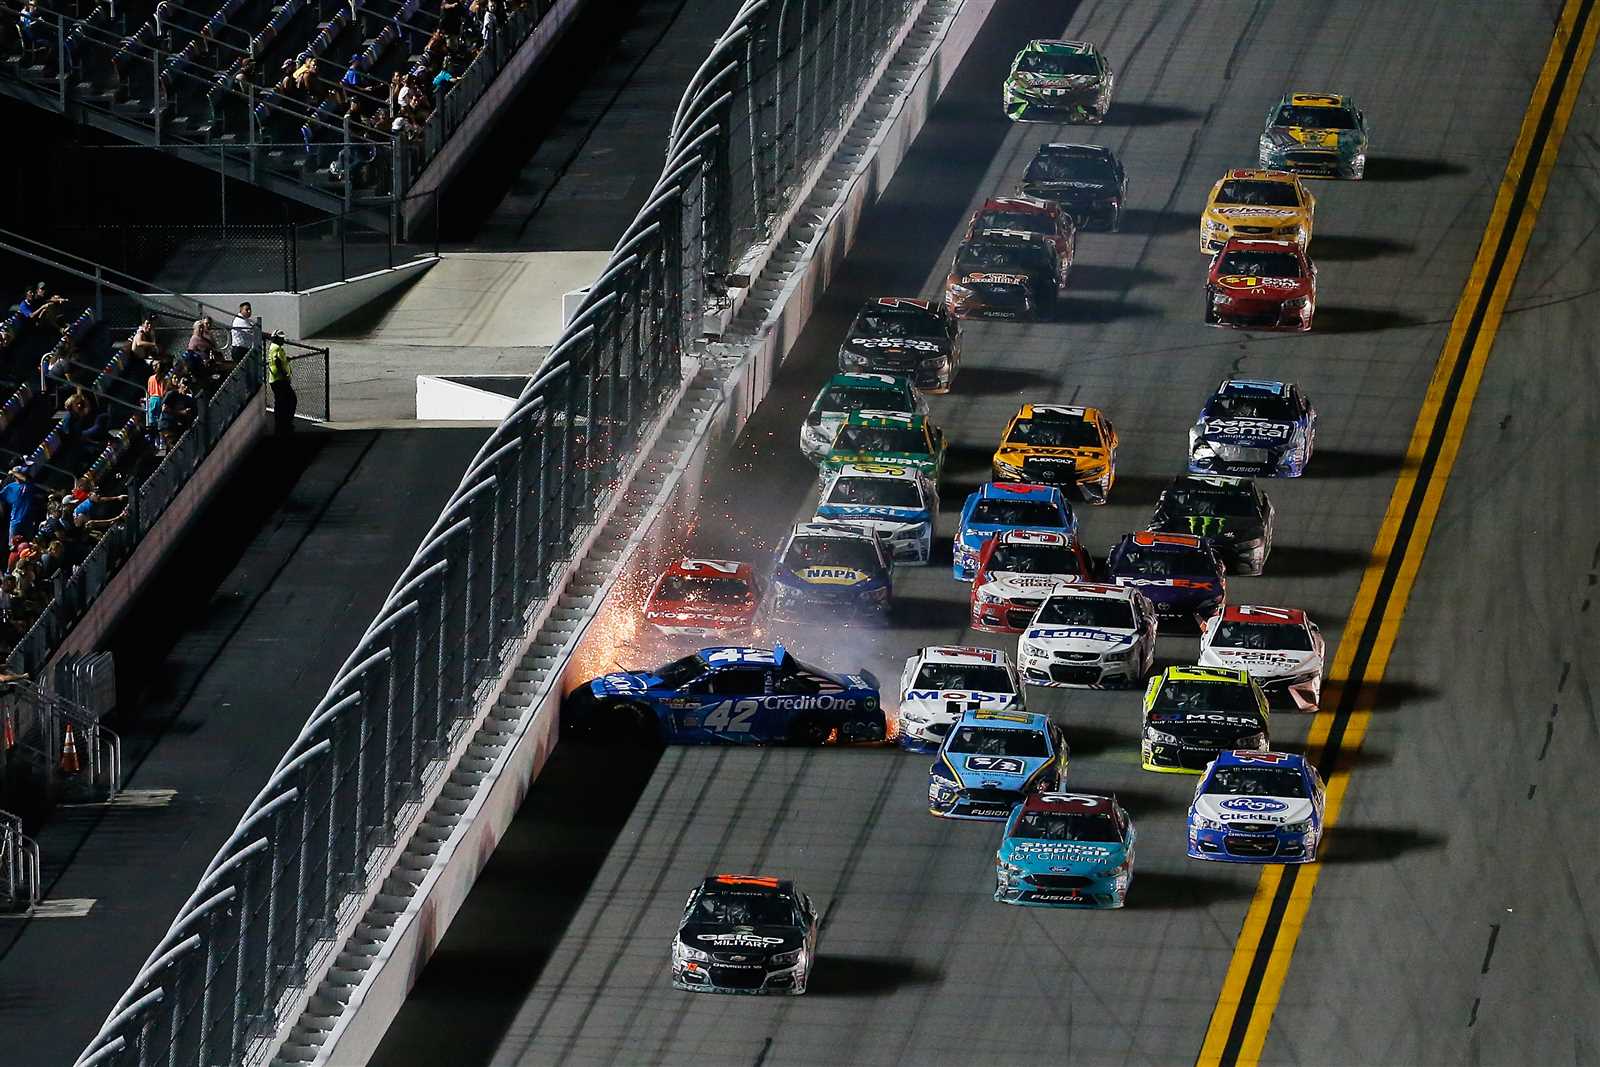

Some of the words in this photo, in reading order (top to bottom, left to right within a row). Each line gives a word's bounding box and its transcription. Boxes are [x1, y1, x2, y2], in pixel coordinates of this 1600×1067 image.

[1209, 418, 1290, 430] Aspen
[1204, 425, 1289, 439] Dental
[831, 455, 934, 466] SUBWAY
[807, 569, 856, 579] NAPA
[1115, 576, 1213, 591] FedEx
[703, 699, 759, 732] 42
[1186, 713, 1259, 725] MOEN
[1228, 798, 1284, 811] Kroger
[971, 808, 1010, 817] FUSION
[1219, 813, 1287, 824] ClickList
[1014, 846, 1111, 856] Hospitals
[1020, 842, 1107, 852] Shriners
[1009, 853, 1031, 862] for
[1037, 853, 1108, 865] Children
[1031, 894, 1084, 902] FUSION
[696, 934, 785, 944] GEICO
[713, 940, 769, 948] MILITARY
